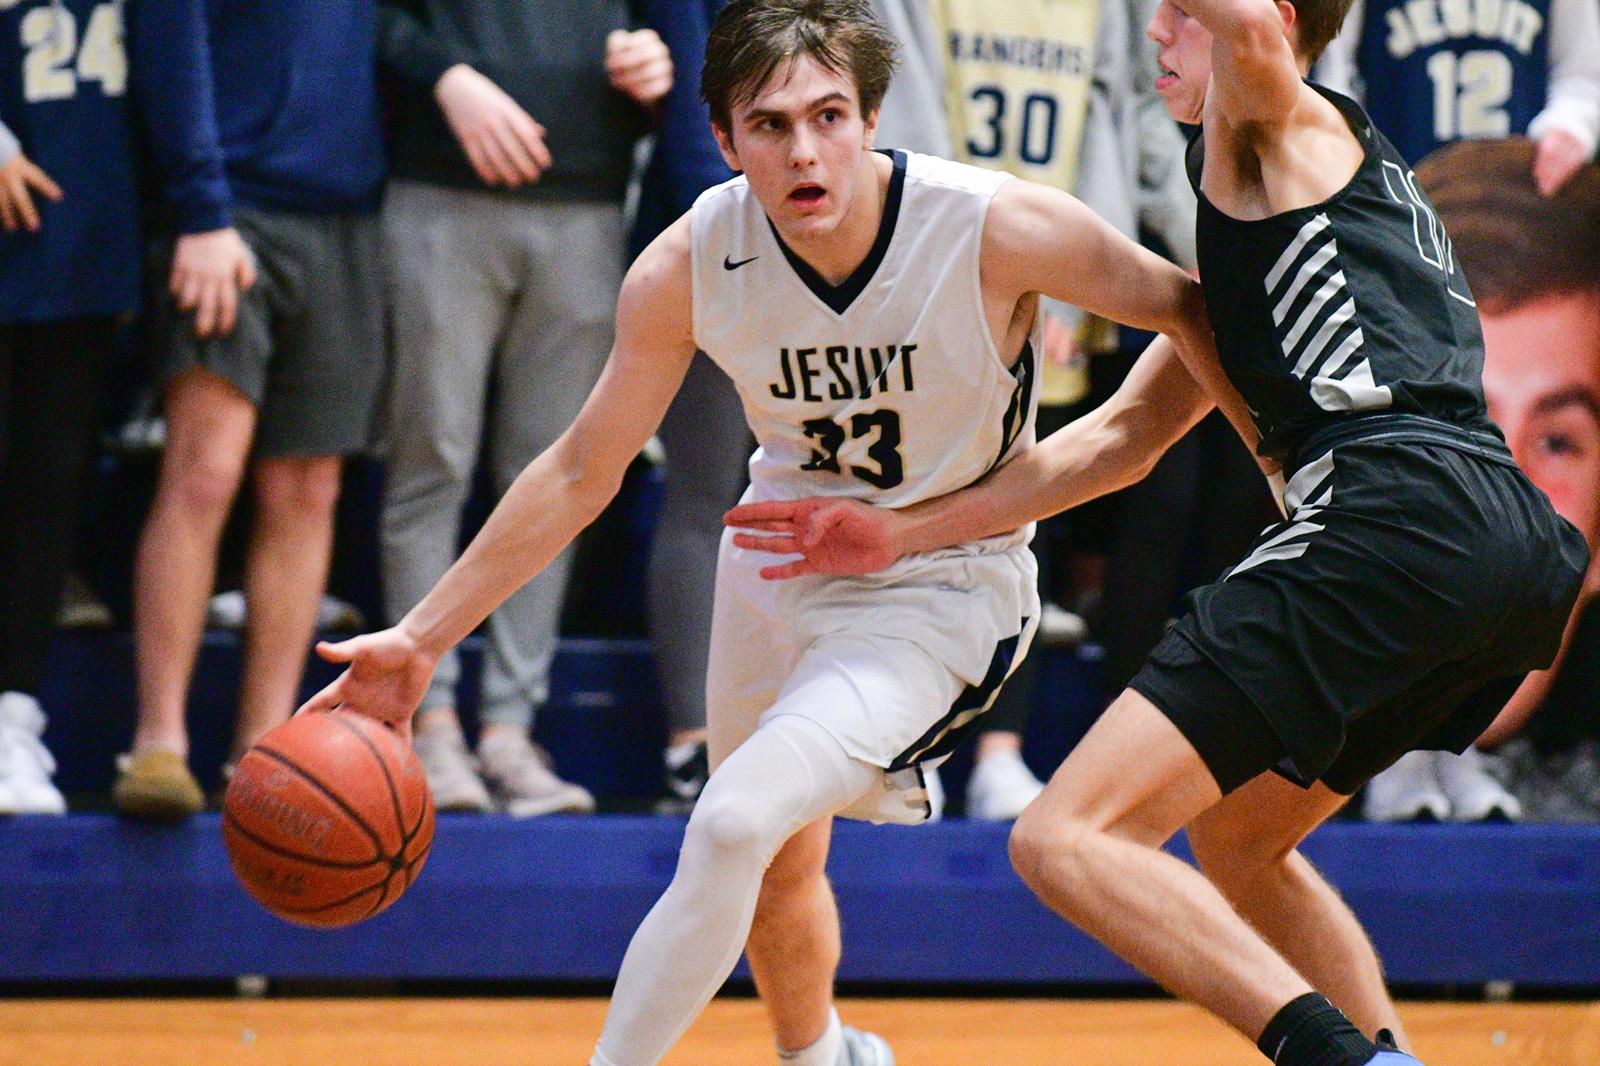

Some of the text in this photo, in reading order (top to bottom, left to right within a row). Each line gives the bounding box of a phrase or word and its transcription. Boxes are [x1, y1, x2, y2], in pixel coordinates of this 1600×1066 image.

[19, 2, 128, 103] 24
[1385, 0, 1544, 59] JESUIT
[966, 84, 1058, 165] 30
[1427, 49, 1514, 142] 12
[769, 343, 918, 402] JESUIT
